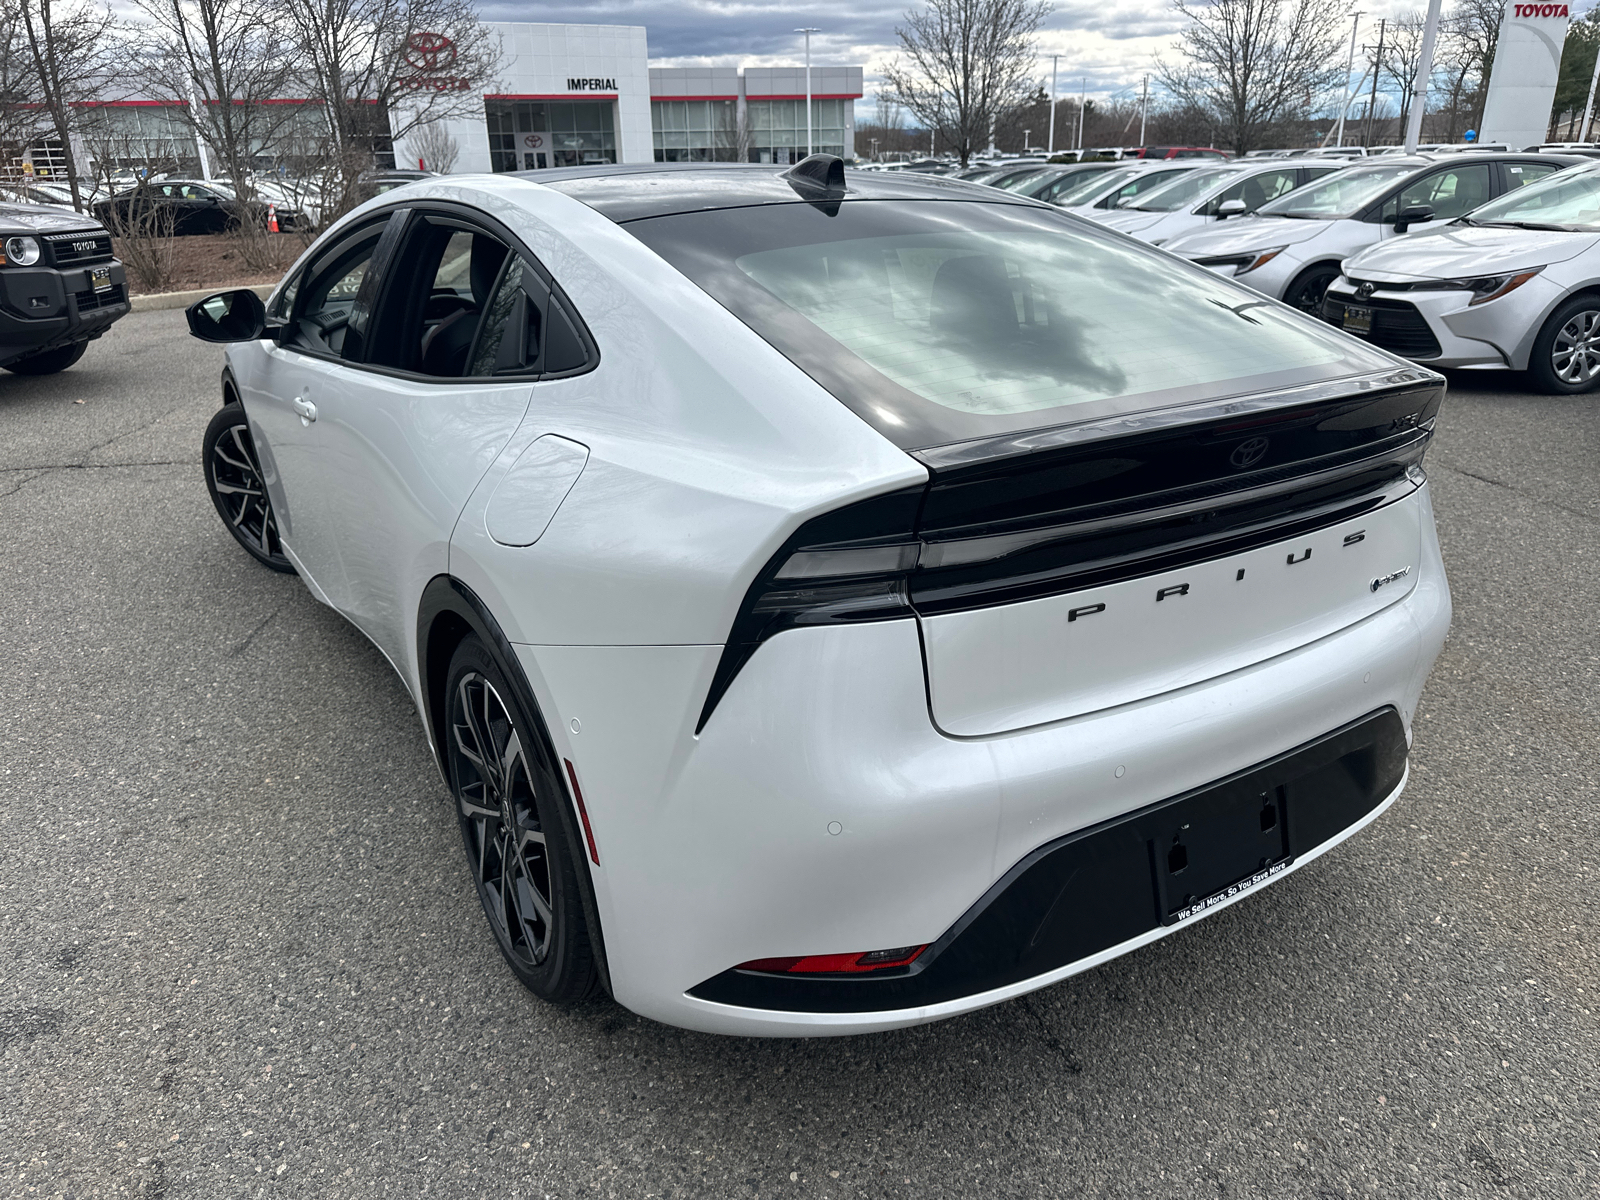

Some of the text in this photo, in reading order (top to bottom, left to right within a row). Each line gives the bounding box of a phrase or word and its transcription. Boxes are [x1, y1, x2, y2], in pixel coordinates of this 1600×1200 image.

[1514, 4, 1569, 18] TOYOTA
[567, 78, 618, 91] IMPERIAL
[72, 240, 98, 252] TOYOTA
[1067, 529, 1366, 622] PRIUS
[1178, 862, 1286, 921] We Sell More, So You Save More
